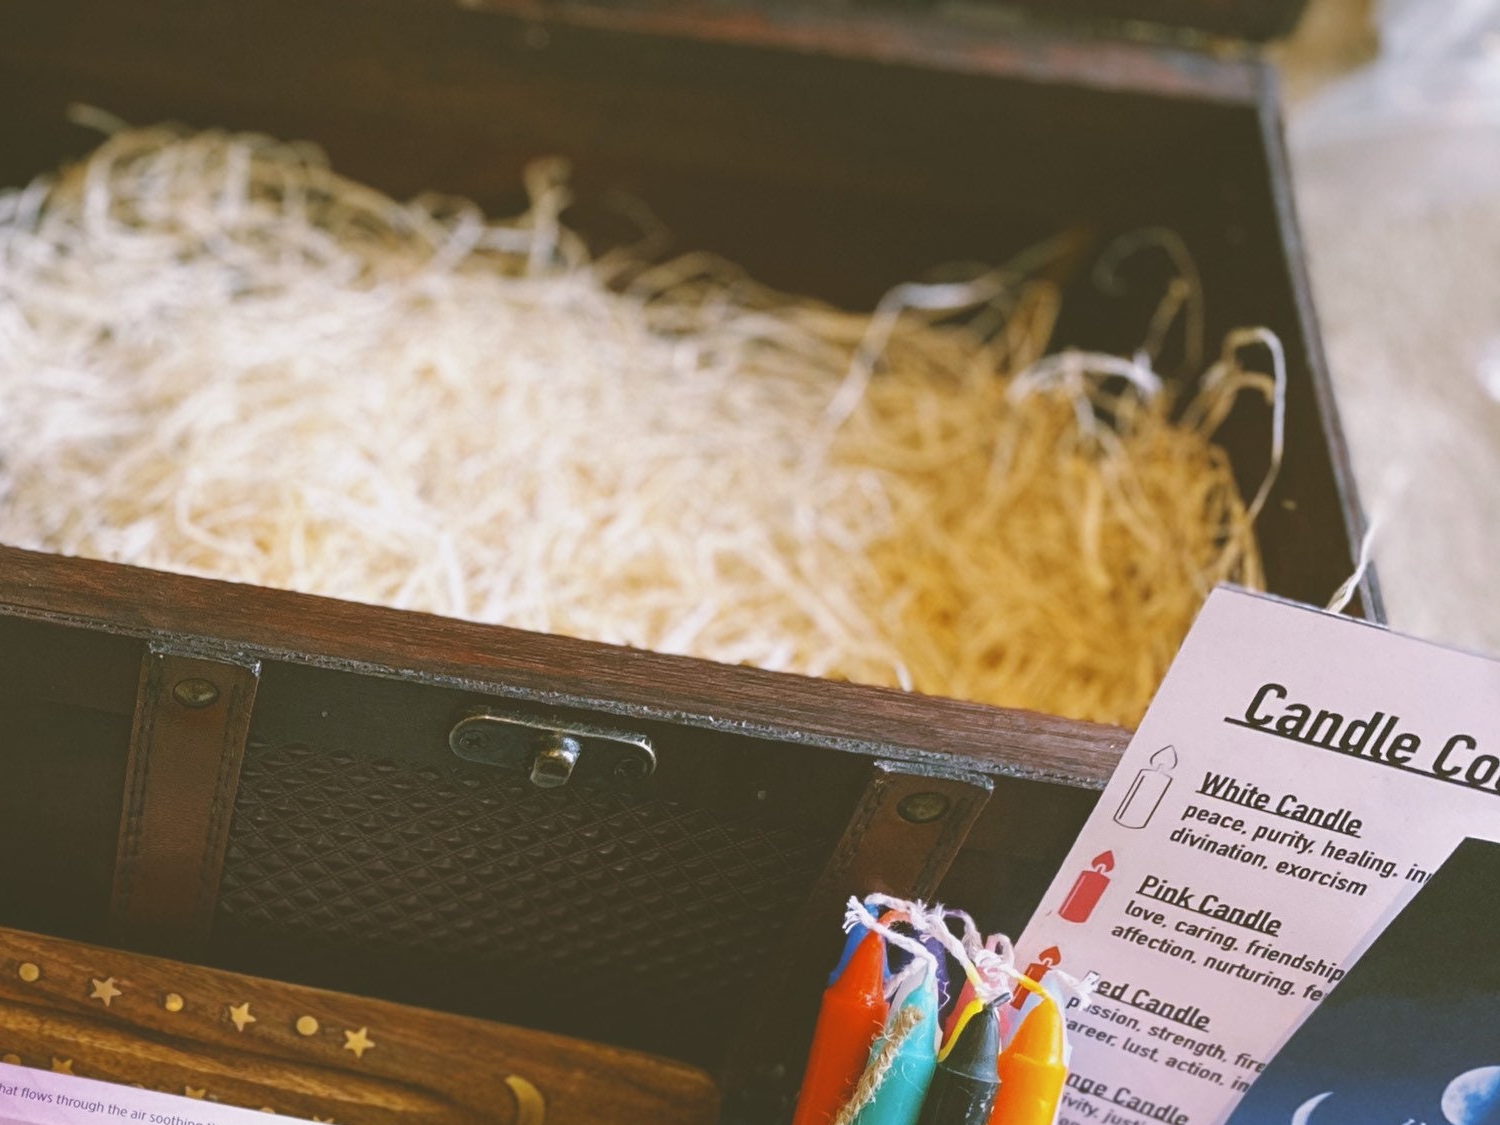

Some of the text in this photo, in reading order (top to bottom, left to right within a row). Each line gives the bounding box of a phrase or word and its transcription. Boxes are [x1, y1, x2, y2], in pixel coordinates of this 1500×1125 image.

[1246, 683, 1421, 764] Candle
[1201, 771, 1363, 836] White Candle
[1138, 874, 1283, 935] Pink Candle
[1276, 861, 1367, 896] exorcism
[1084, 970, 1211, 1032] ed Candle
[21, 1088, 52, 1103] flows
[56, 1095, 104, 1112] through
[108, 1104, 127, 1117] the
[130, 1111, 146, 1120] air
